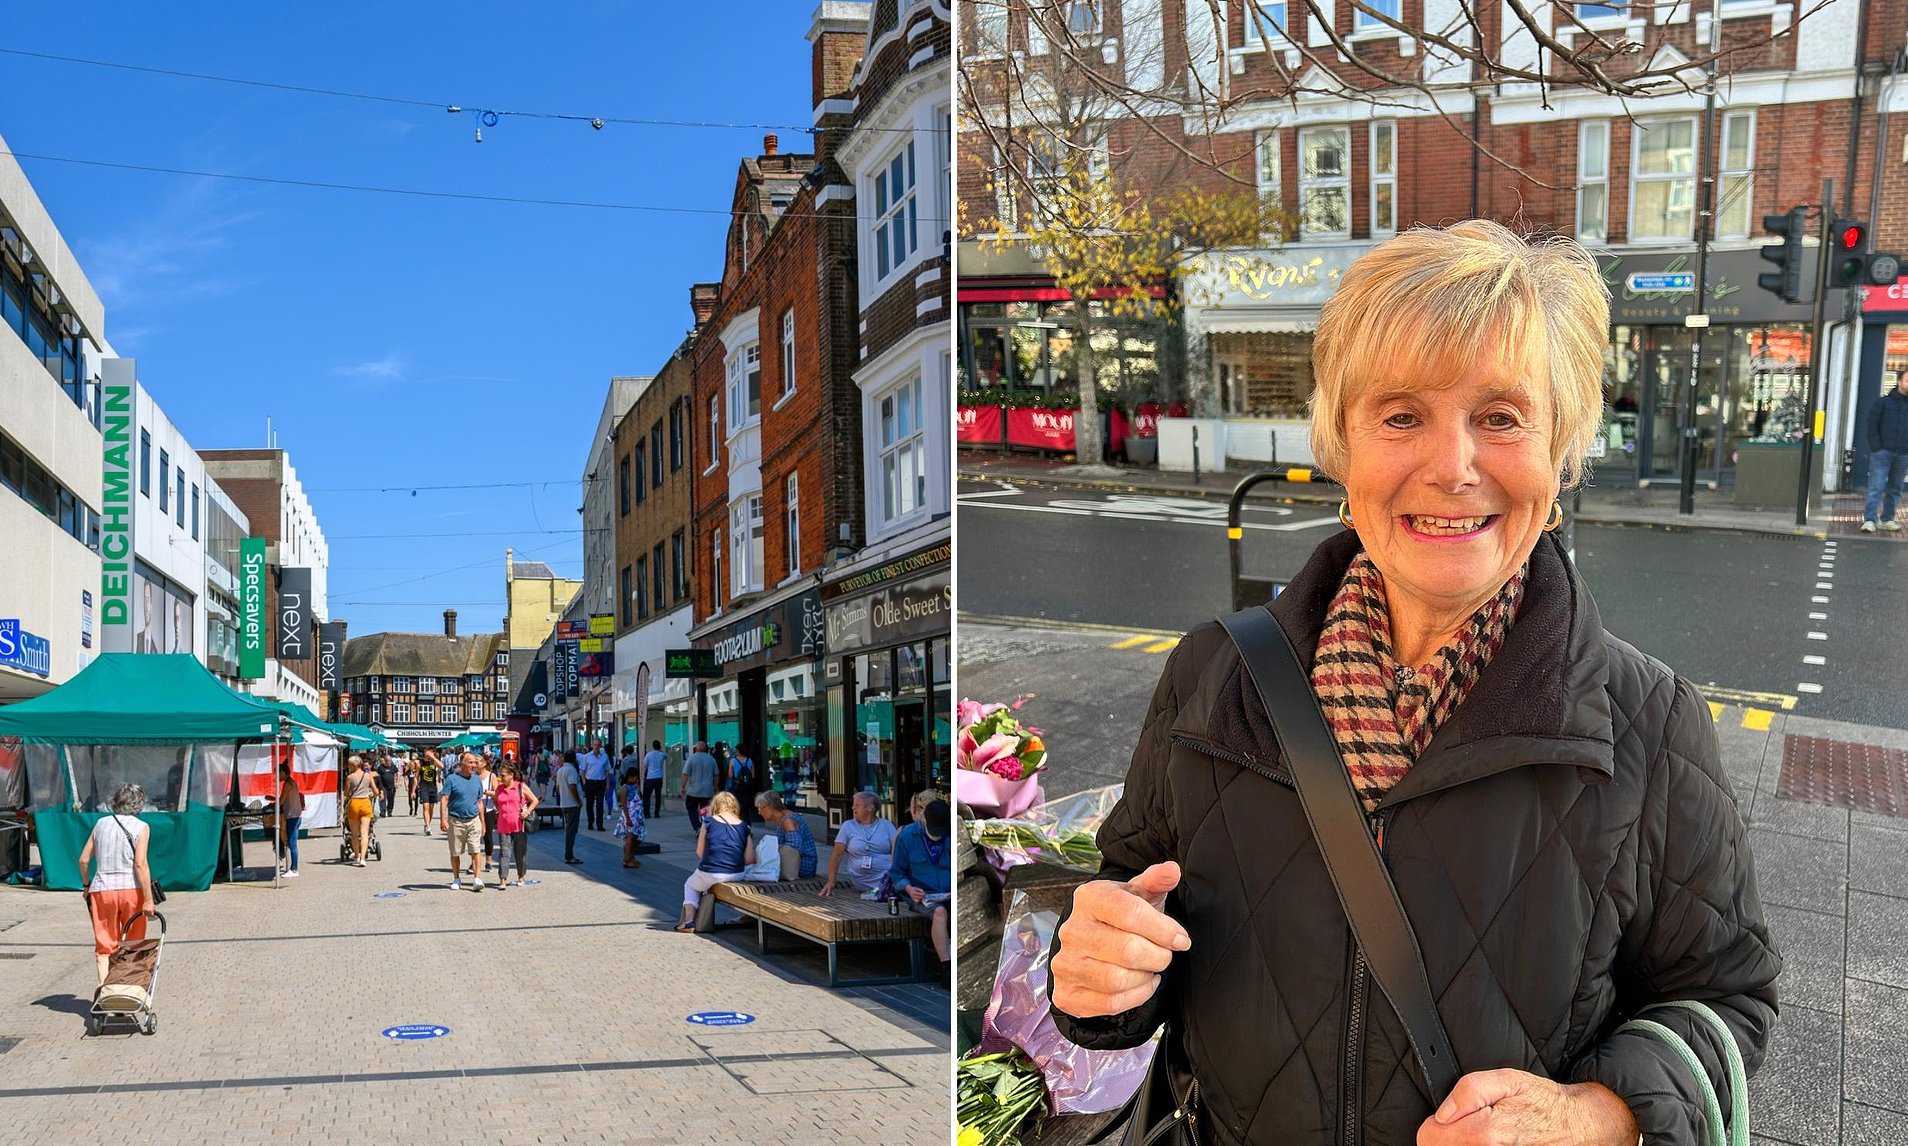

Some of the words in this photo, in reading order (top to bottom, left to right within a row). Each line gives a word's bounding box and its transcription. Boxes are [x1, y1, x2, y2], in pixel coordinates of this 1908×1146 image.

[102, 386, 130, 625] DEICHMANN
[839, 573, 872, 593] PURVEYOR
[872, 569, 882, 582] OF
[881, 562, 905, 579] FINEST
[242, 553, 263, 650] Specsavers
[842, 607, 867, 630] Simms
[873, 600, 900, 628] Olde
[903, 594, 940, 621] Sweet
[282, 593, 301, 656] next
[714, 626, 761, 666] FOOTASYLUM
[321, 642, 336, 687] next
[556, 651, 565, 697] TOPSHOP
